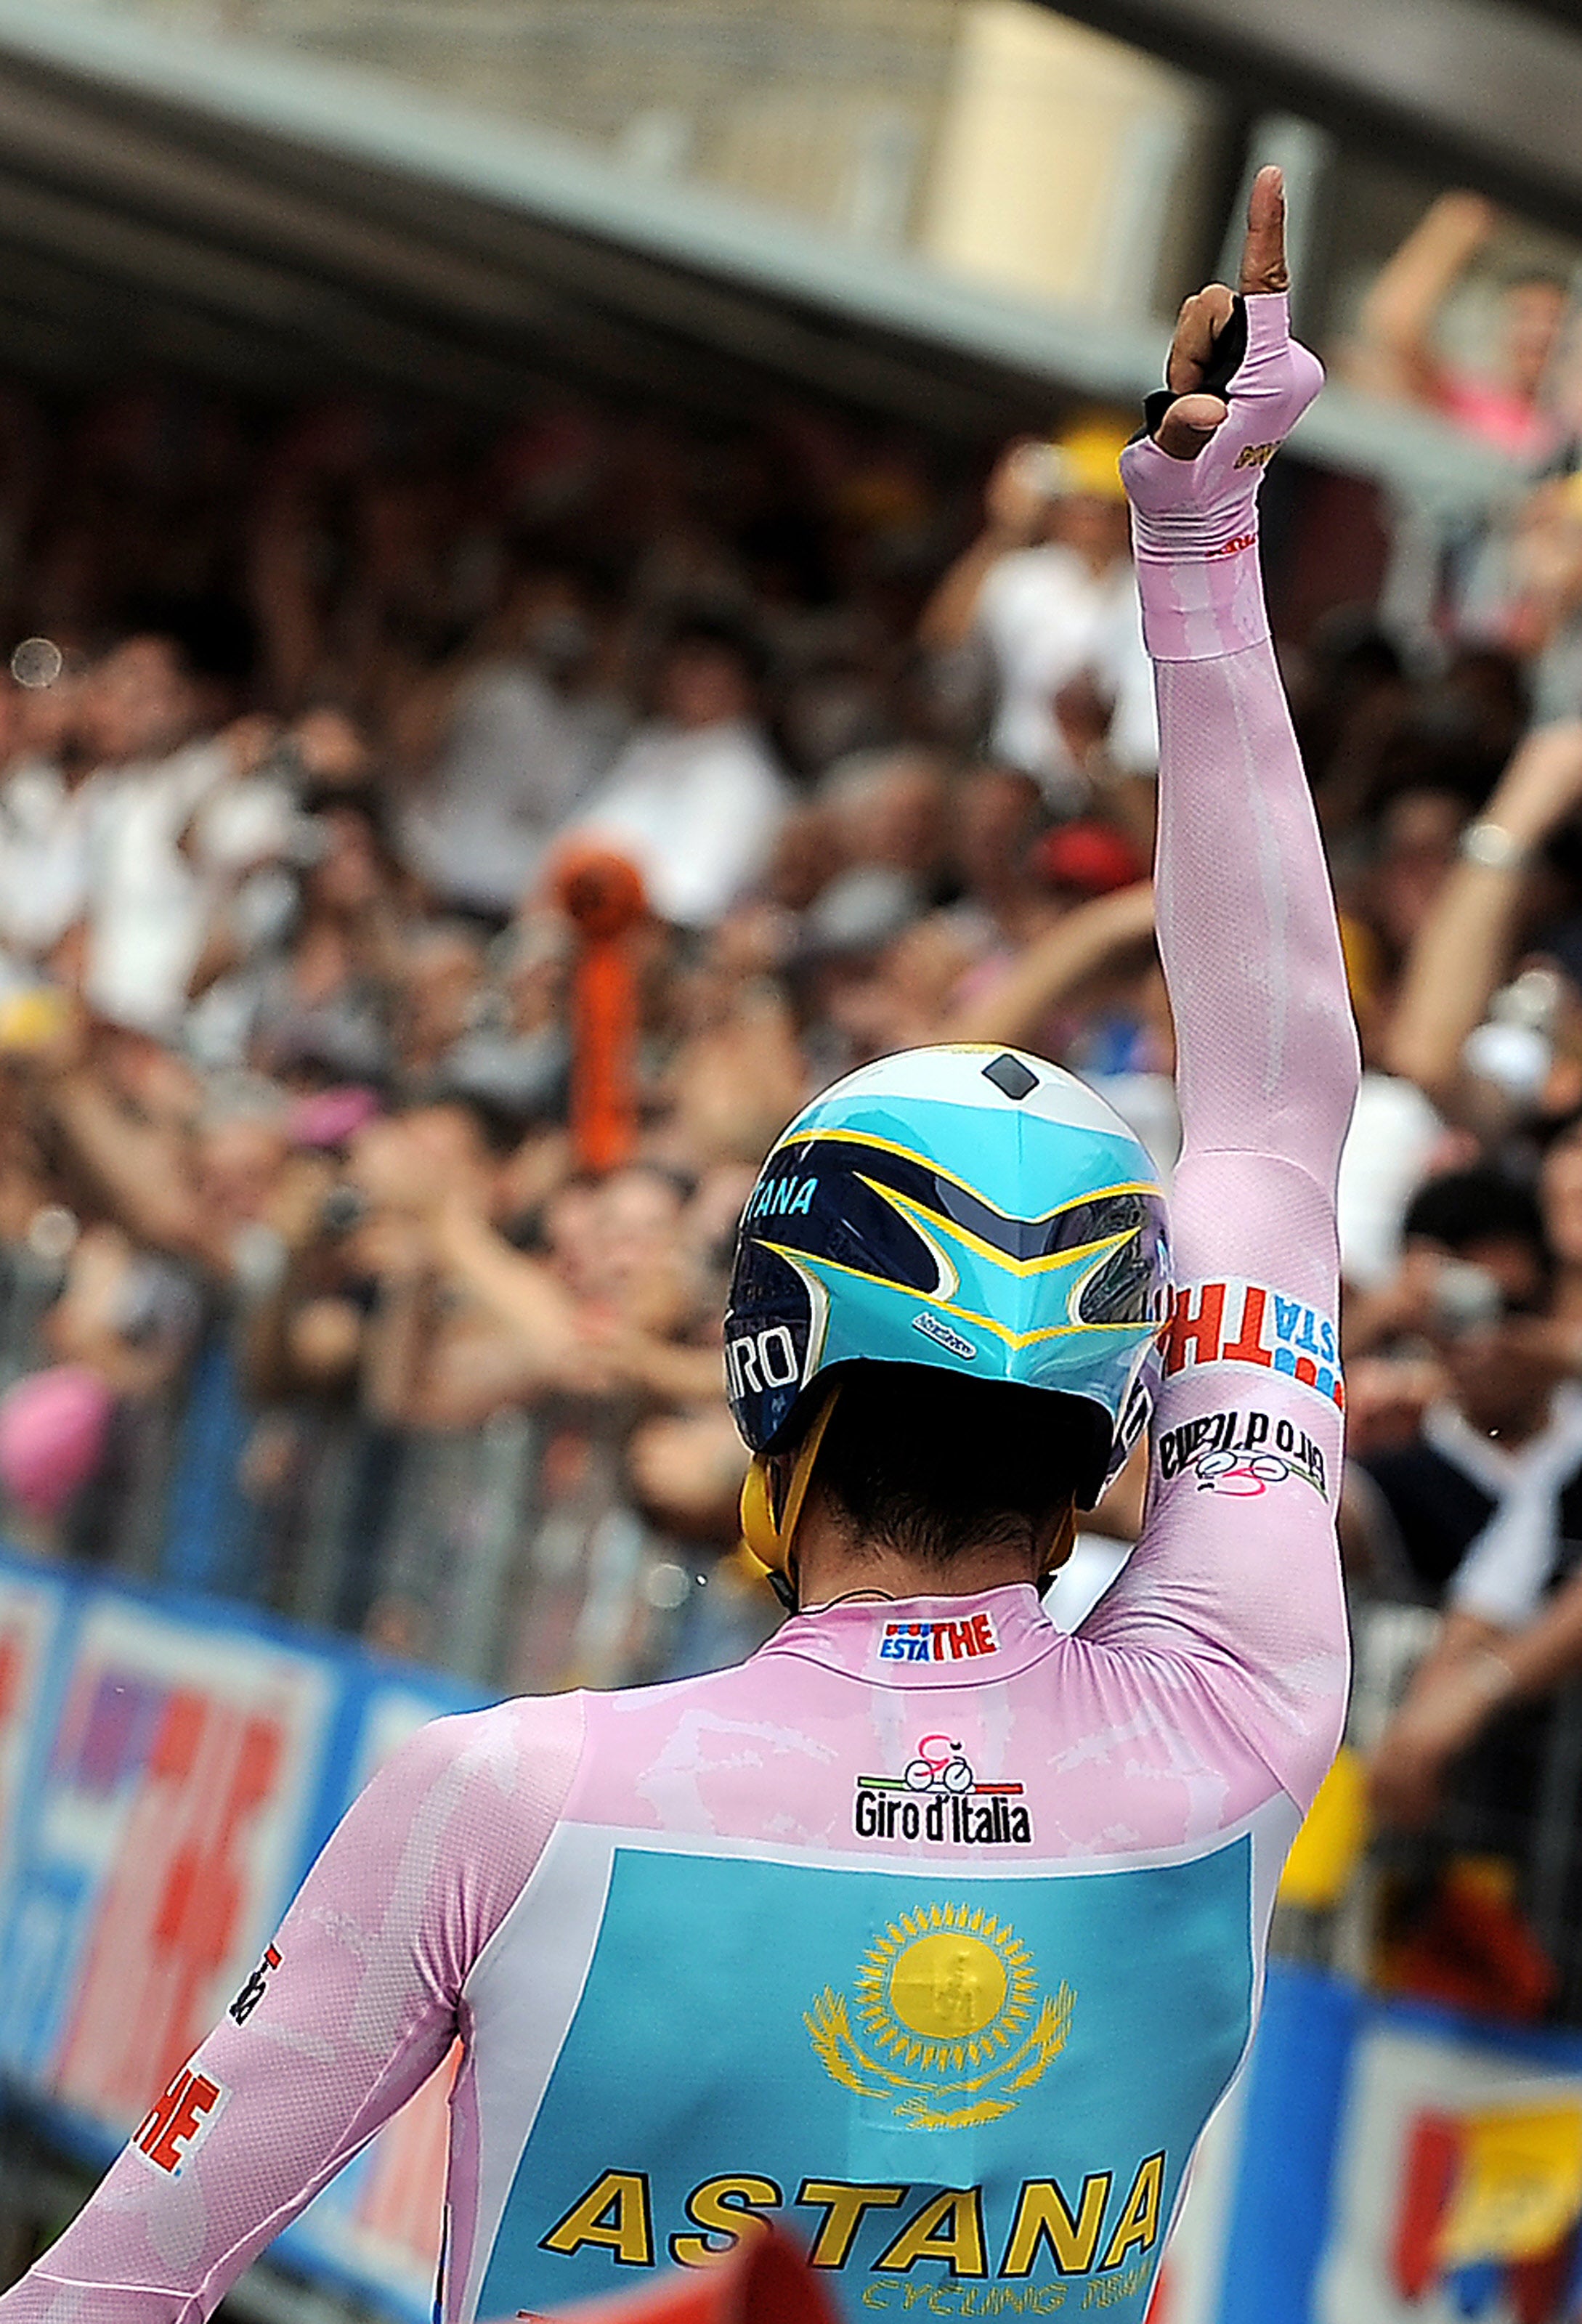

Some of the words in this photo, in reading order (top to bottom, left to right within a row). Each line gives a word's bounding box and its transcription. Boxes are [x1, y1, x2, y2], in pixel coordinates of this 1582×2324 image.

[1275, 1295, 1336, 1363] STA
[880, 1638, 930, 1662] ESTA
[932, 1613, 997, 1661] THE
[855, 1790, 920, 1840] Giro
[925, 1793, 1031, 1844] d'Italia
[538, 2148, 1167, 2279] ASTANA
[861, 2278, 1069, 2317] CYCLING
